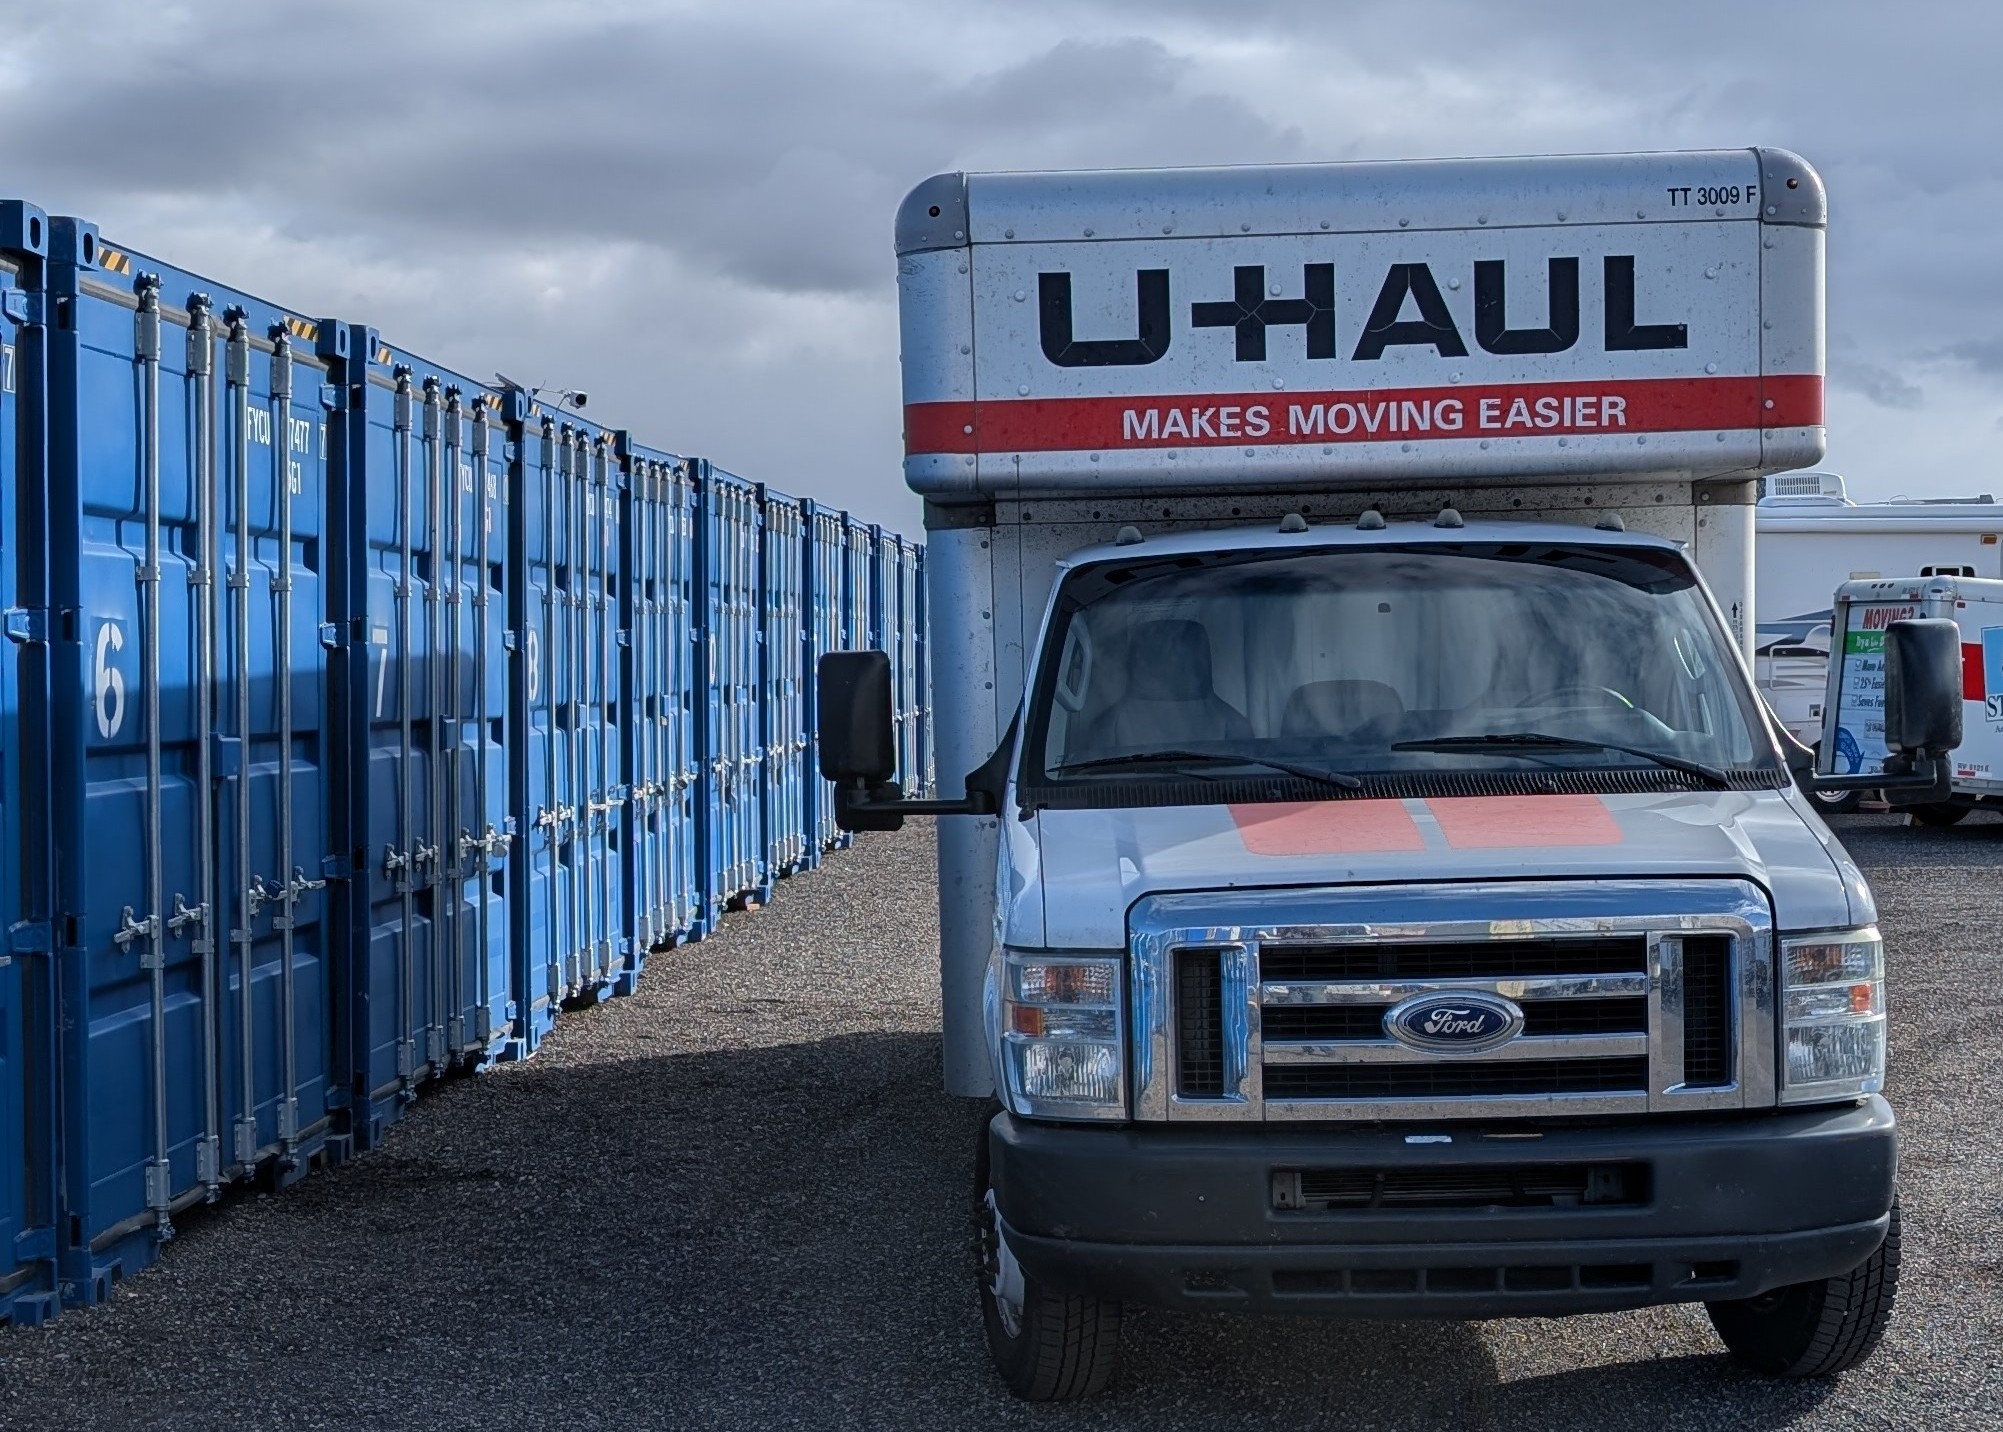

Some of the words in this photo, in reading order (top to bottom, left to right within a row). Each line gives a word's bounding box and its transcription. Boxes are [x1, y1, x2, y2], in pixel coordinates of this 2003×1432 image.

[1667, 187, 1692, 206] TT
[1697, 186, 1740, 205] 3009
[1746, 185, 1757, 204] F
[1038, 255, 1688, 368] U-HAUL
[247, 406, 271, 446] FYCU
[1123, 405, 1270, 440] MAKES
[1289, 398, 1464, 435] MOVING
[1479, 396, 1627, 429] EASIER
[96, 622, 124, 739] 6
[372, 628, 388, 718] 7
[528, 630, 538, 702] 8
[1424, 1008, 1485, 1034] Ford
